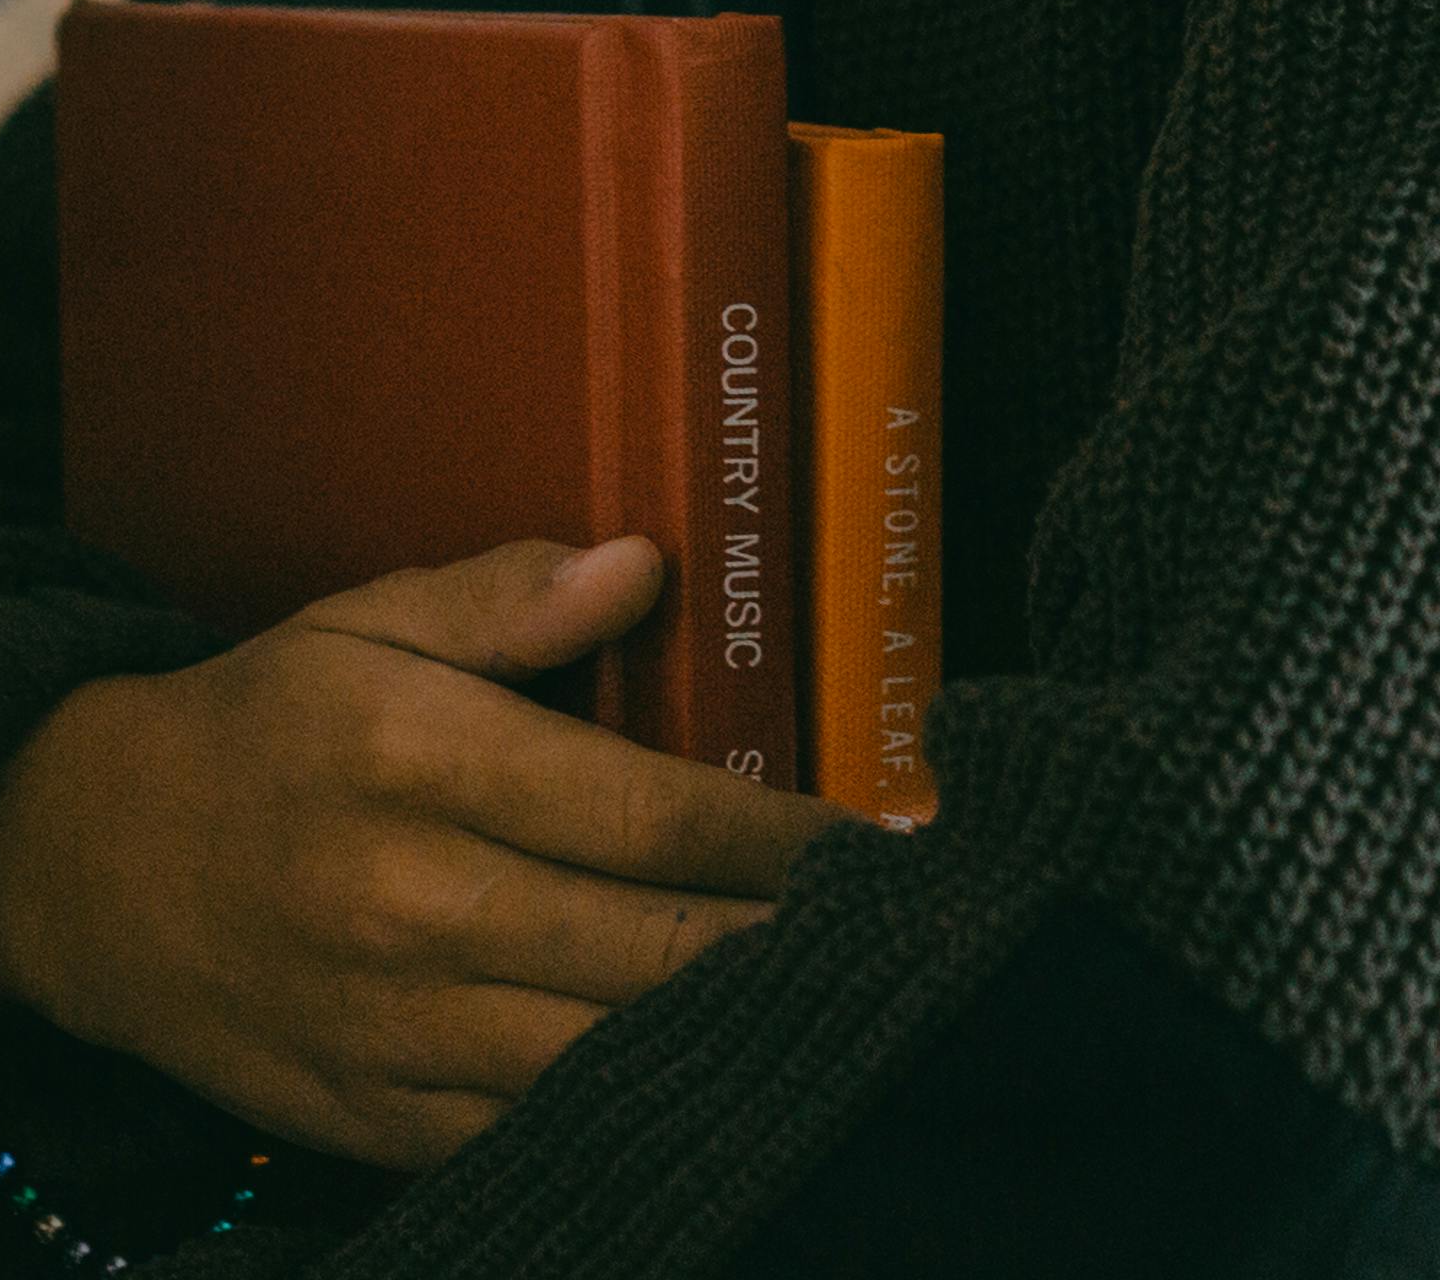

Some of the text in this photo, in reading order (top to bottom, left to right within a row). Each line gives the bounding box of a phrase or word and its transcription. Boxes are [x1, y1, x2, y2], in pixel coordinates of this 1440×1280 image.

[886, 406, 919, 430] A
[721, 302, 764, 782] COUNTRY MUSIC S
[878, 452, 919, 607] STONE,
[882, 629, 915, 654] A
